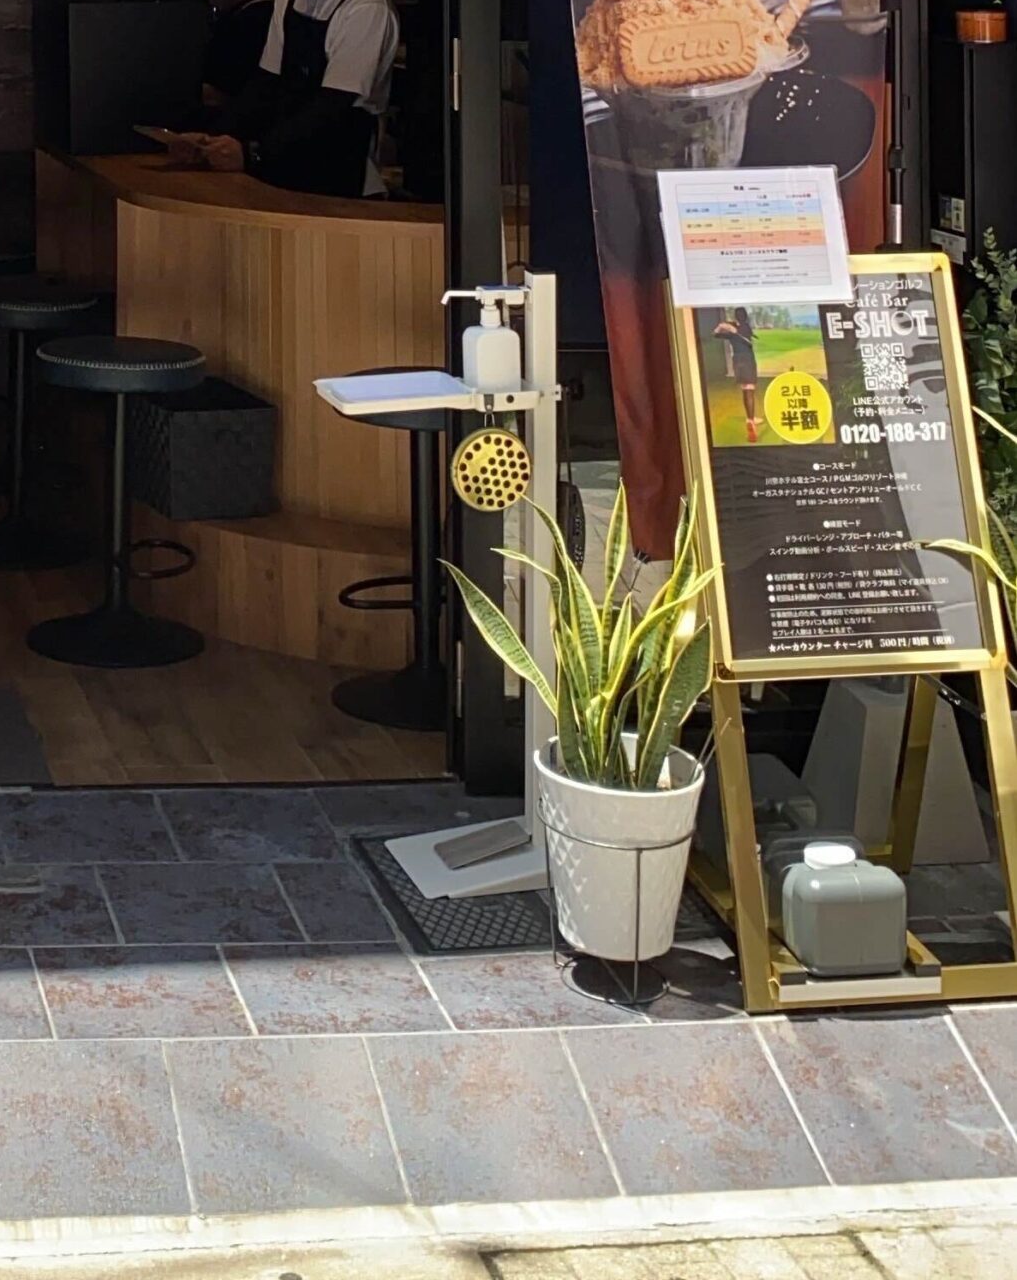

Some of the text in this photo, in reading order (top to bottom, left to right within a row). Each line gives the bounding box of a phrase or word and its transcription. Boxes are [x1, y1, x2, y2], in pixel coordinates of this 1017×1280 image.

[882, 293, 909, 307] Bar
[826, 310, 930, 339] E-SHOT
[781, 385, 812, 397] 2人目
[781, 411, 820, 431] 半額
[840, 421, 947, 445] 0120-188-317
